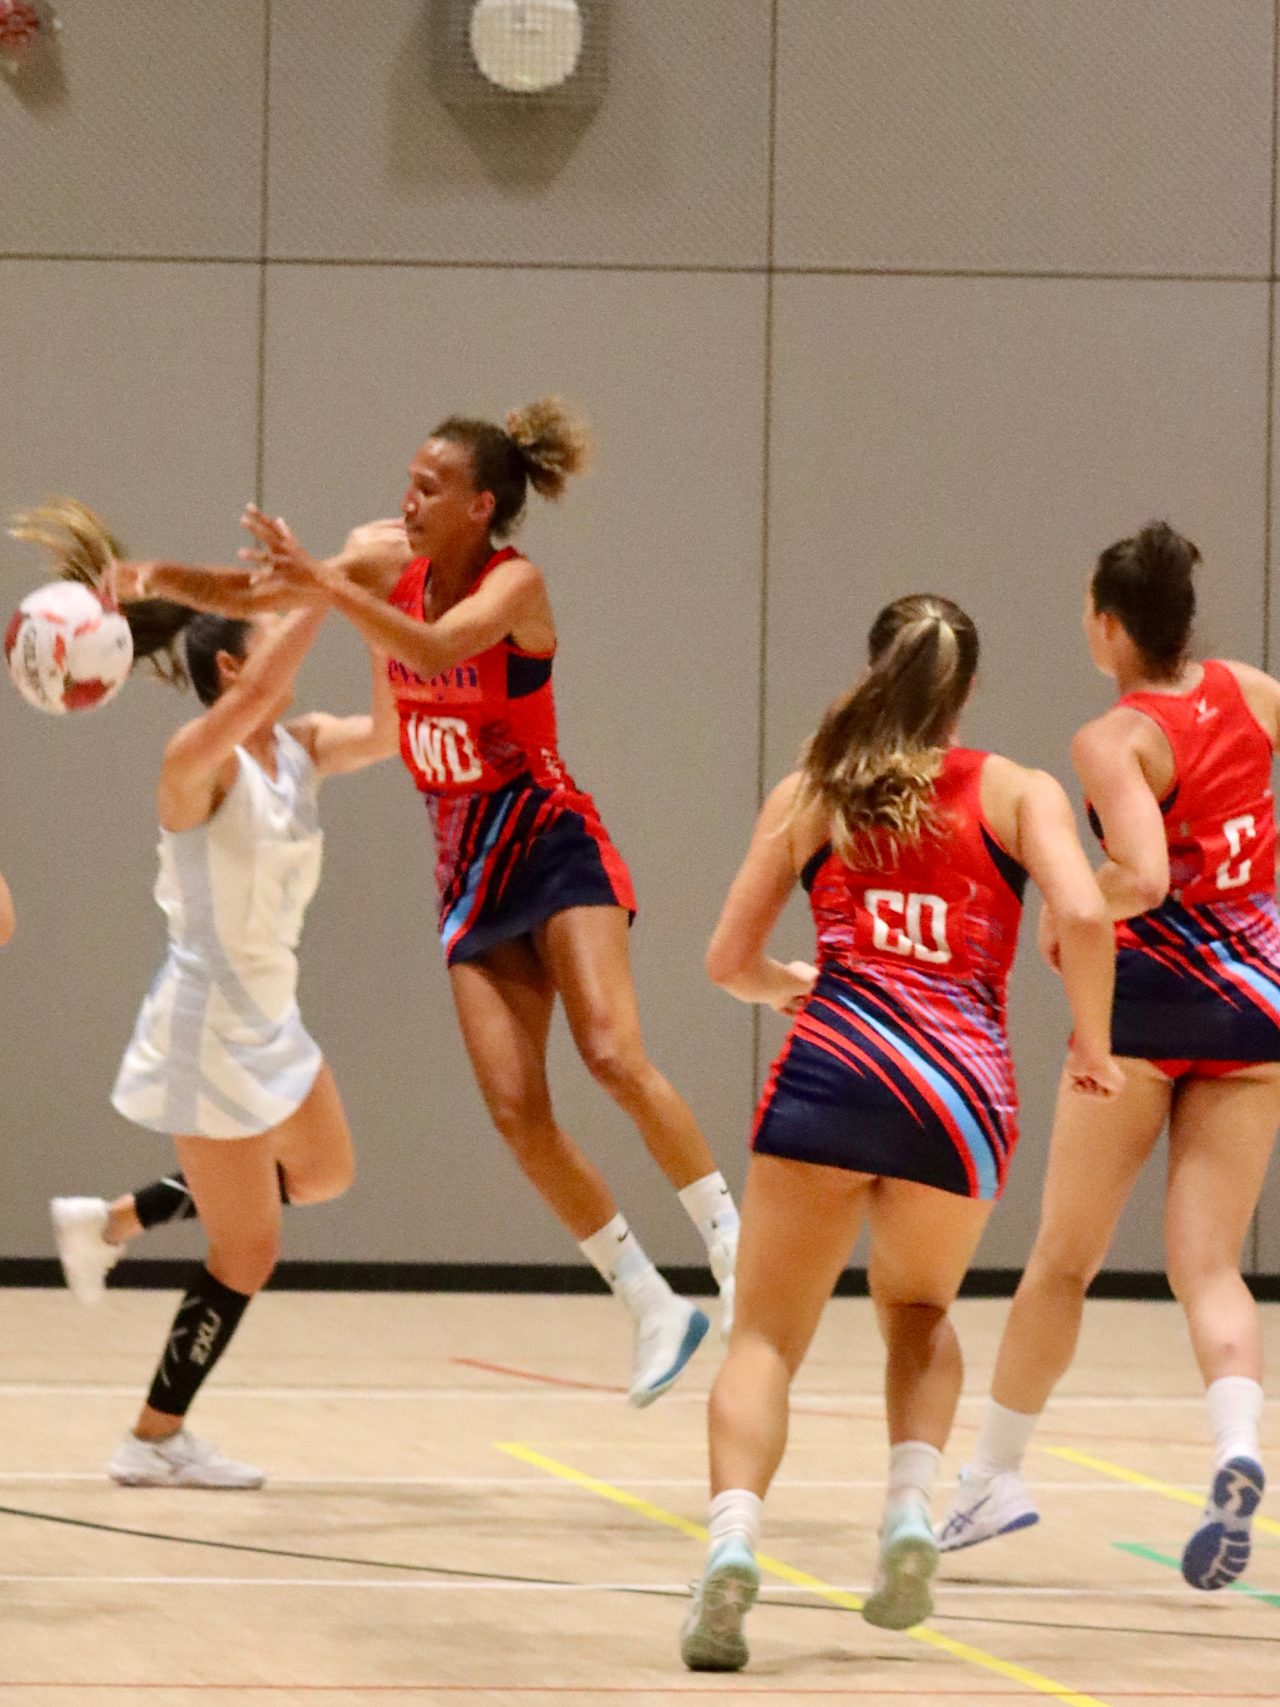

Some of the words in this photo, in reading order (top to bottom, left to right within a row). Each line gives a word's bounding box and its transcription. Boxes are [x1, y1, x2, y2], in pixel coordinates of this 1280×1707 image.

[407, 712, 483, 783] WD
[1216, 814, 1256, 891] C
[864, 889, 952, 965] GD
